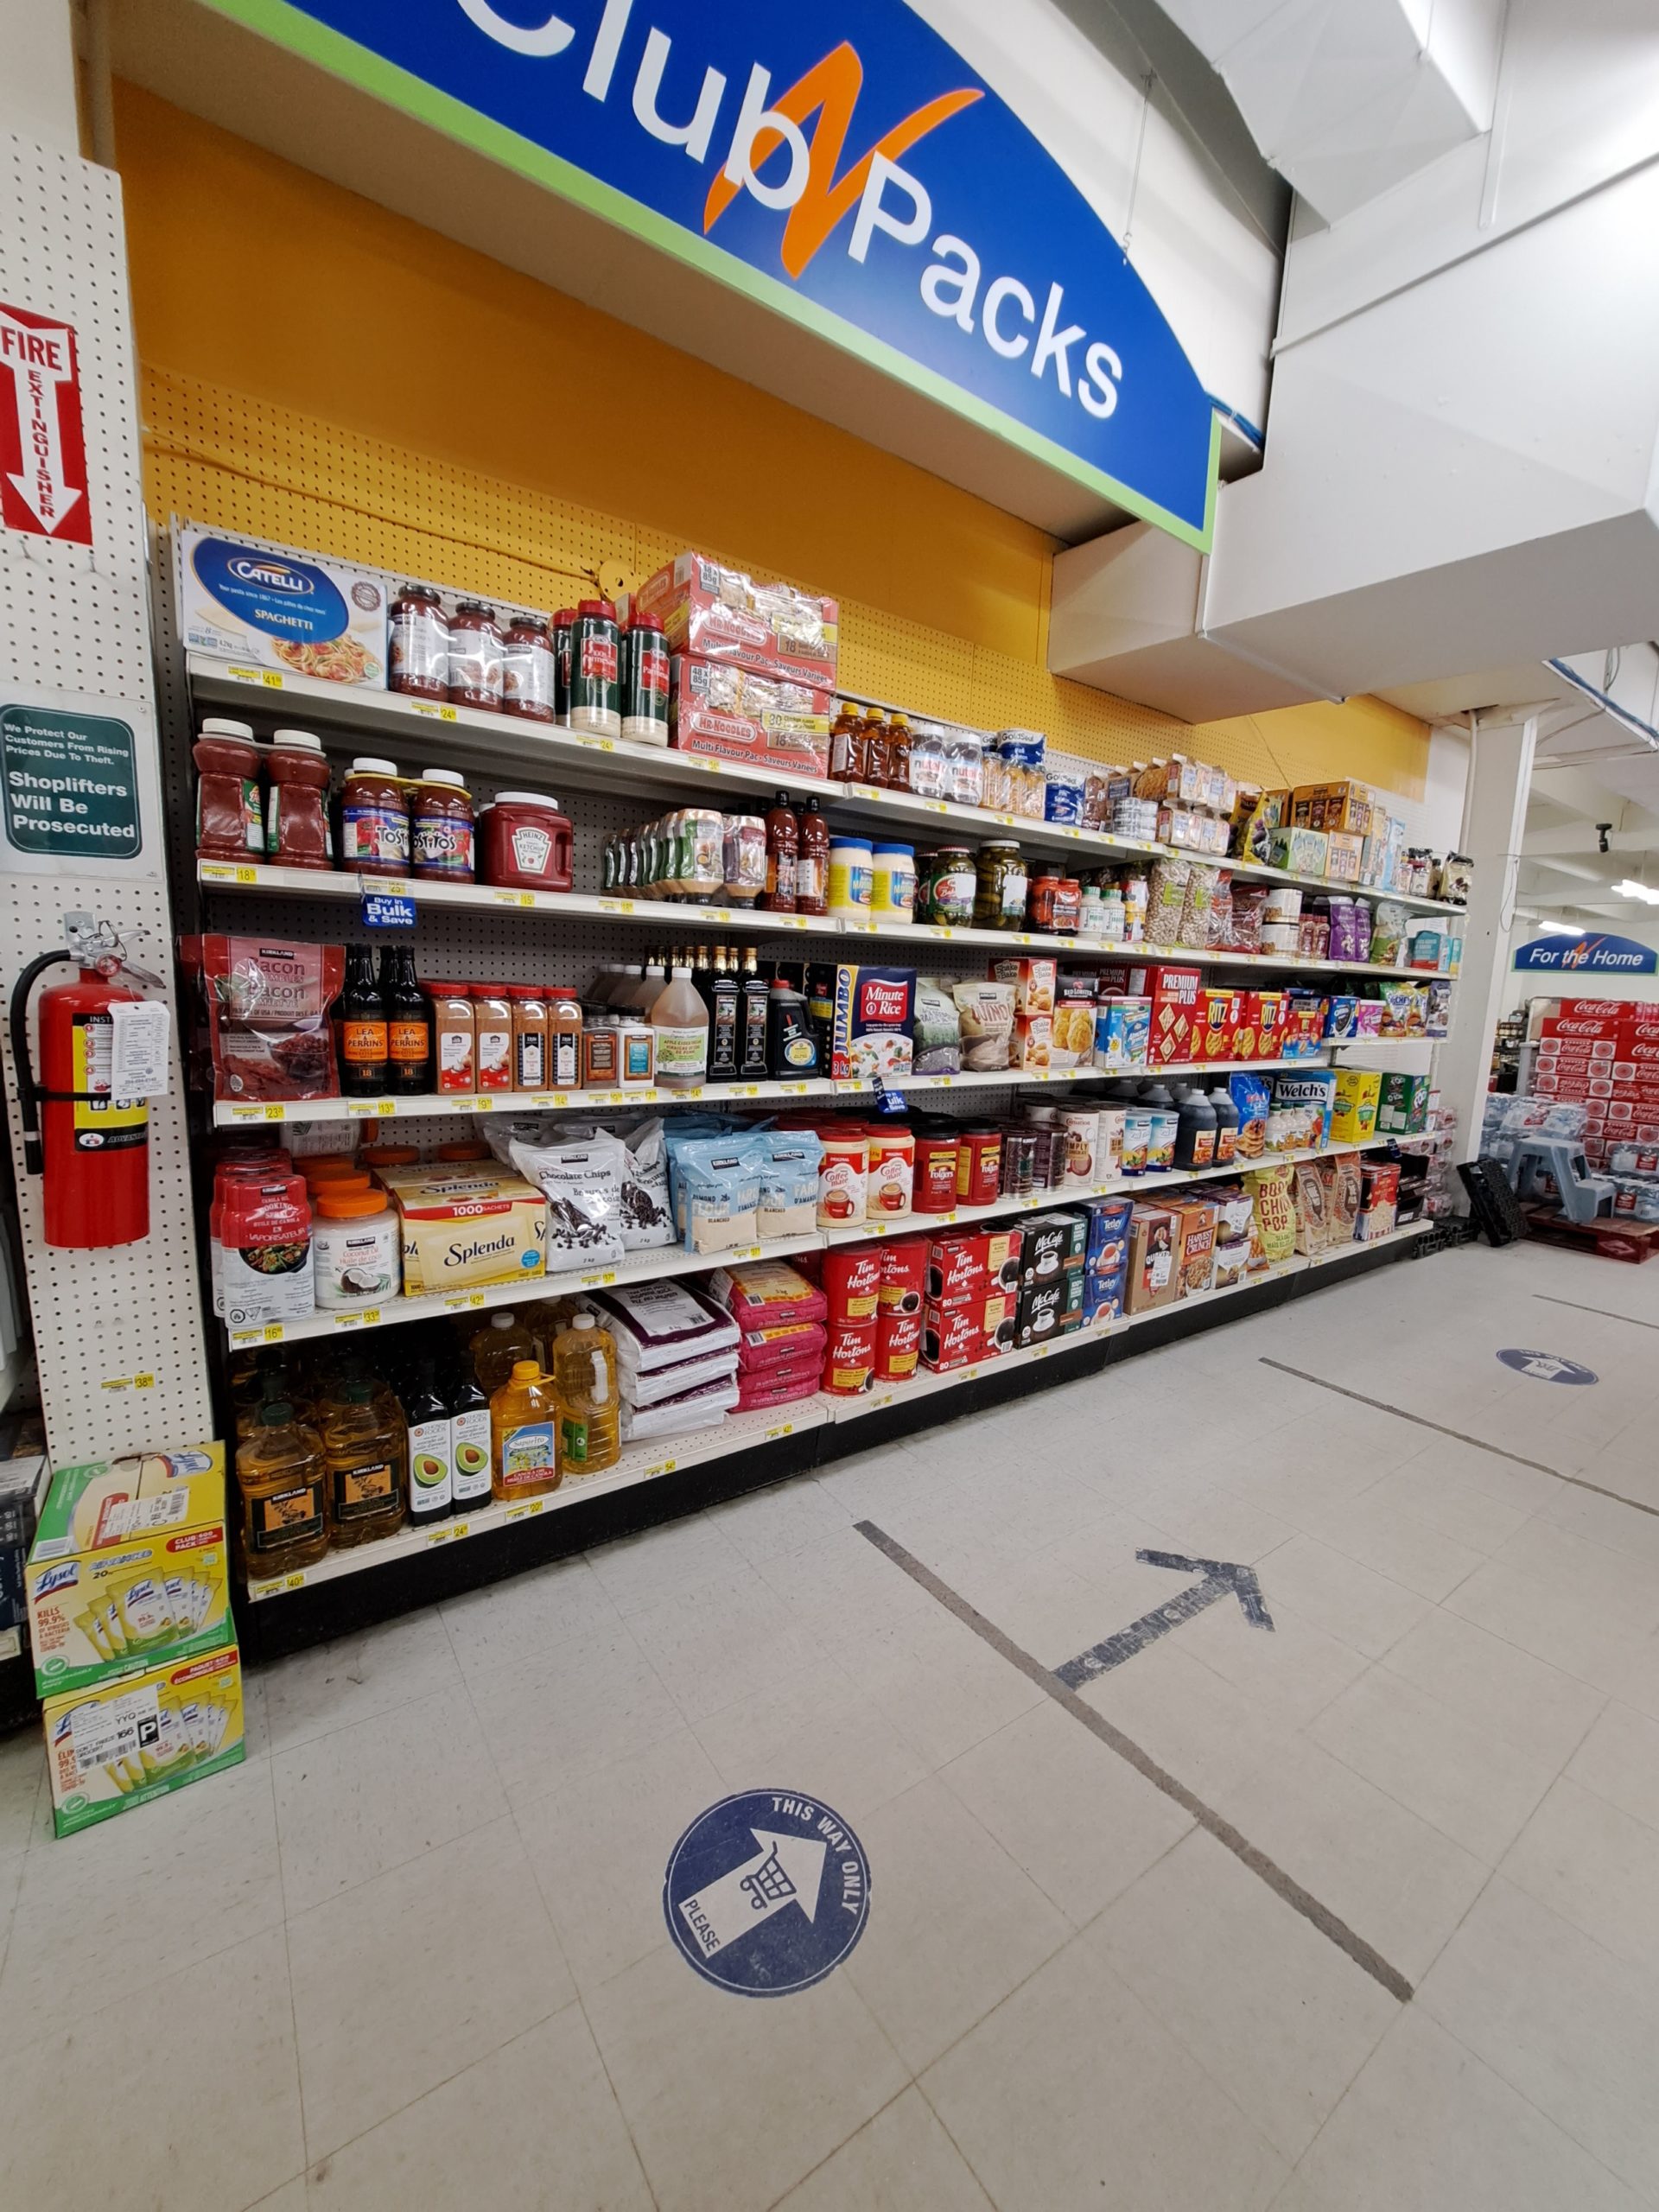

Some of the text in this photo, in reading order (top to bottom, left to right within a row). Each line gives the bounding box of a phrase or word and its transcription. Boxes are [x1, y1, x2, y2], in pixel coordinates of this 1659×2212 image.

[848, 150, 1124, 419] Packs
[1, 324, 62, 372] FIRE
[27, 369, 55, 518] EXTINGUISHER
[237, 562, 302, 591] CATELLI
[254, 608, 314, 631] SPAGHETTI
[693, 667, 703, 677] 48
[693, 676, 709, 686] 85g
[3, 722, 88, 741] We Protect Our
[714, 720, 751, 739] NOODLES
[5, 734, 129, 758] Customers From Rising
[6, 745, 115, 766] Prices Due To Theft.
[693, 740, 792, 768] Multi Flavour Pac Saveurs
[9, 770, 128, 798] Shoplifters
[10, 792, 89, 814] Will Be
[13, 814, 136, 838] Prosecuted
[522, 831, 543, 842] HEINZ
[374, 897, 393, 906] Buy
[366, 903, 413, 917] Bulk
[381, 916, 413, 925] Save
[262, 949, 294, 957] KIRKLAND
[1529, 948, 1643, 966] For the Home
[1162, 973, 1198, 990] PREMIUM
[865, 986, 905, 1002] Minute
[1178, 989, 1197, 1006] PLUS
[832, 966, 852, 1057] JUMBO
[880, 1001, 902, 1016] Rice
[1207, 1001, 1228, 1025] RITZ
[1261, 1001, 1278, 1025] RITZ
[348, 1039, 384, 1048] PERRINS
[391, 1039, 425, 1047] PERRINS
[839, 1061, 850, 1076] kg
[1279, 1084, 1326, 1098] Welch's
[712, 1158, 739, 1166] KIRKLAND
[539, 1170, 611, 1180] Chocolate Chips
[824, 1170, 849, 1184] Coffee
[880, 1165, 903, 1178] Coffee
[930, 1169, 955, 1179] Folgers
[420, 1180, 499, 1195] Splenda
[830, 1179, 849, 1188] mate
[452, 1204, 483, 1217] 1000
[1103, 1218, 1122, 1230] Tetley
[1263, 1217, 1287, 1232] POP
[249, 1228, 305, 1242] VAPORISATEUR
[1036, 1230, 1064, 1251] McCafé
[1188, 1230, 1214, 1243] HARVEST
[443, 1234, 515, 1268] Splenda
[1186, 1241, 1211, 1255] CRUNCH
[955, 1250, 973, 1263] Tim
[856, 1259, 874, 1274] Tim
[947, 1262, 983, 1287] Hortons
[1097, 1278, 1116, 1290] Tetley
[942, 1298, 952, 1308] 80
[1033, 1287, 1061, 1309] McCafé
[897, 1319, 916, 1333] Tim
[951, 1313, 969, 1328] Tim
[841, 1332, 861, 1345] Tim
[944, 1325, 980, 1350] Hortons
[832, 1343, 872, 1359] Hortons
[939, 1363, 950, 1371] 80
[353, 1464, 385, 1476] KIRKLAND
[272, 1487, 307, 1502] KIRKLAND
[175, 1535, 196, 1546] CLUB
[175, 1541, 197, 1551] PACK
[35, 1563, 75, 1592] Lysol
[92, 1571, 109, 1580] 20
[127, 1580, 152, 1599] Lysol
[37, 1606, 60, 1618] KILLS
[37, 1615, 65, 1627] 99.9%
[771, 1796, 863, 1916] THIS WAY ONLY
[683, 1898, 722, 1954] PLEASE
